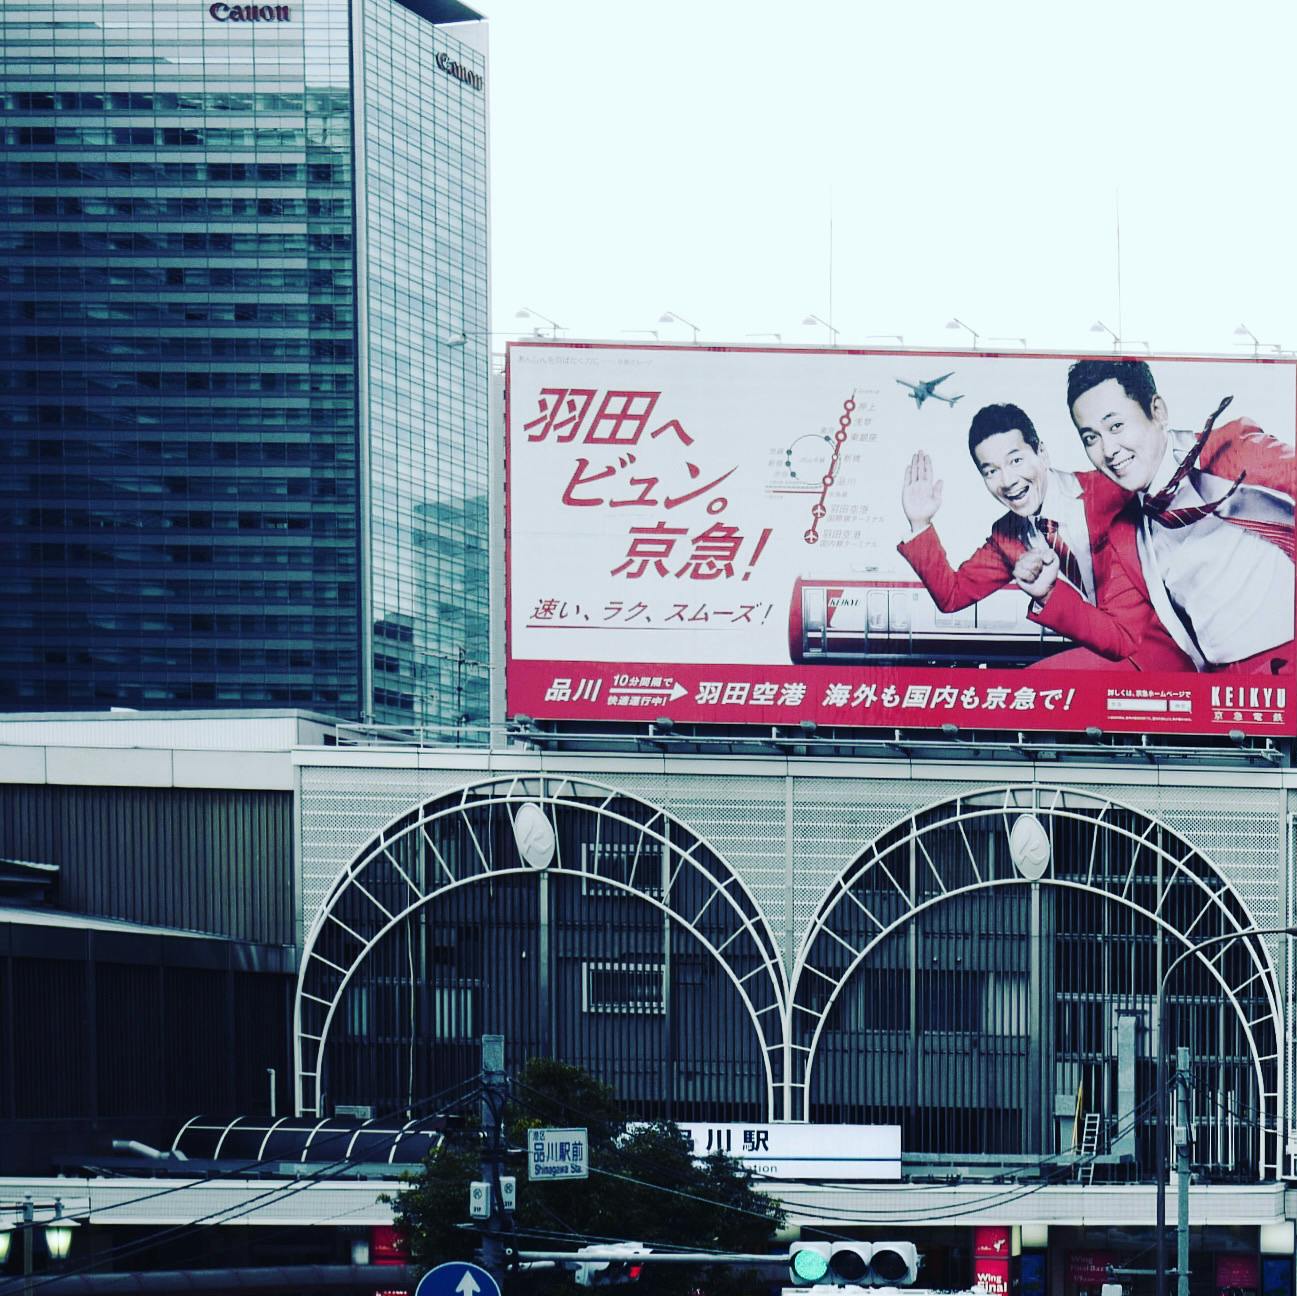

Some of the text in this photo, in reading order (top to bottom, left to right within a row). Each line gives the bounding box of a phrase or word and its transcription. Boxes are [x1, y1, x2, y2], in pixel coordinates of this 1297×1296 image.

[209, 2, 290, 22] Canon
[435, 51, 484, 92] Canon
[523, 388, 695, 446] 羽田へ
[561, 452, 739, 515] ビュン。
[610, 521, 774, 581] 京急!
[544, 678, 602, 702] 品川
[695, 681, 806, 706] 羽田空港
[1211, 686, 1287, 708] KEIKYU
[1213, 711, 1286, 724] 京急電鉄
[533, 1141, 583, 1162] 品川駅前
[534, 1164, 569, 1176] Shinagawa
[977, 1273, 1002, 1284] Wing
